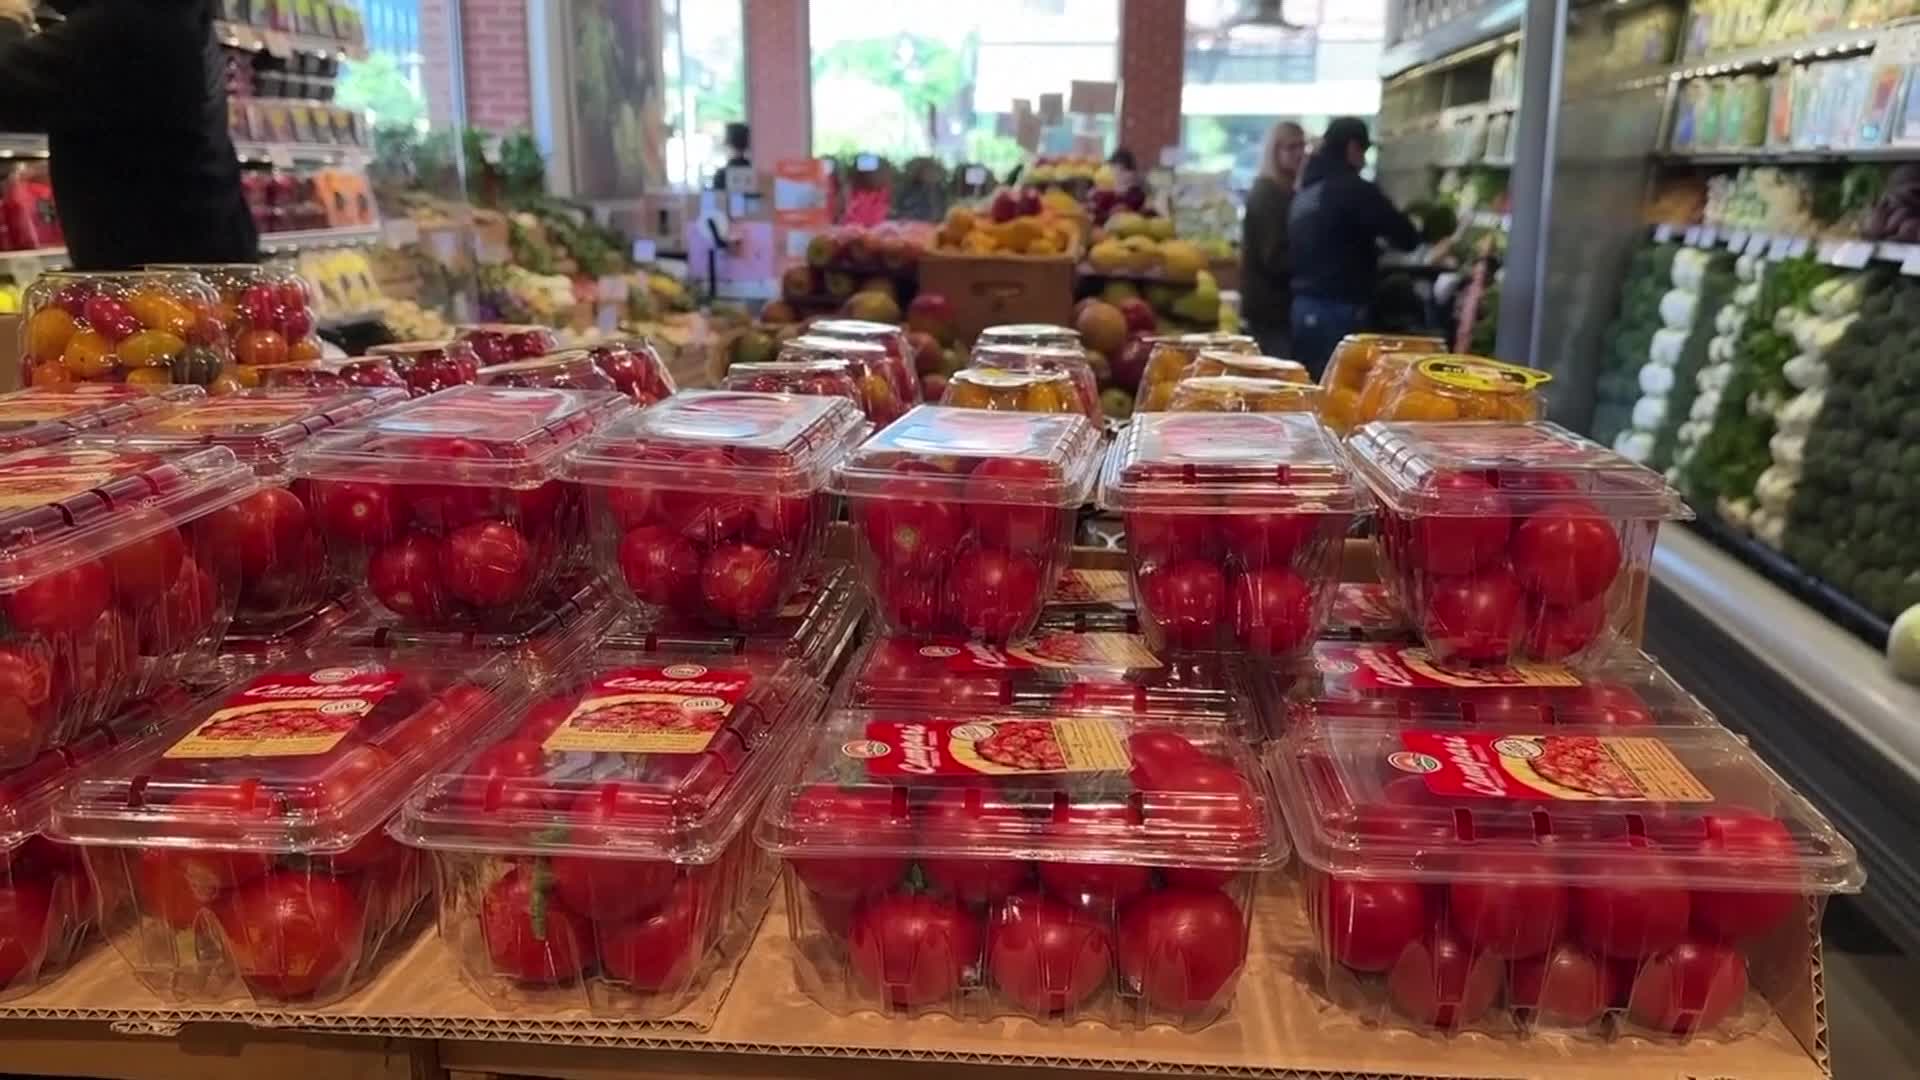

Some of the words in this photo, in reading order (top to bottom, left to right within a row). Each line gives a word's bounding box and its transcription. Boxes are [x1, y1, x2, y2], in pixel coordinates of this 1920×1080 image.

[244, 681, 394, 697] Campari
[603, 677, 745, 691] Campari
[894, 723, 936, 774] Campari
[1432, 734, 1506, 796] Campari
